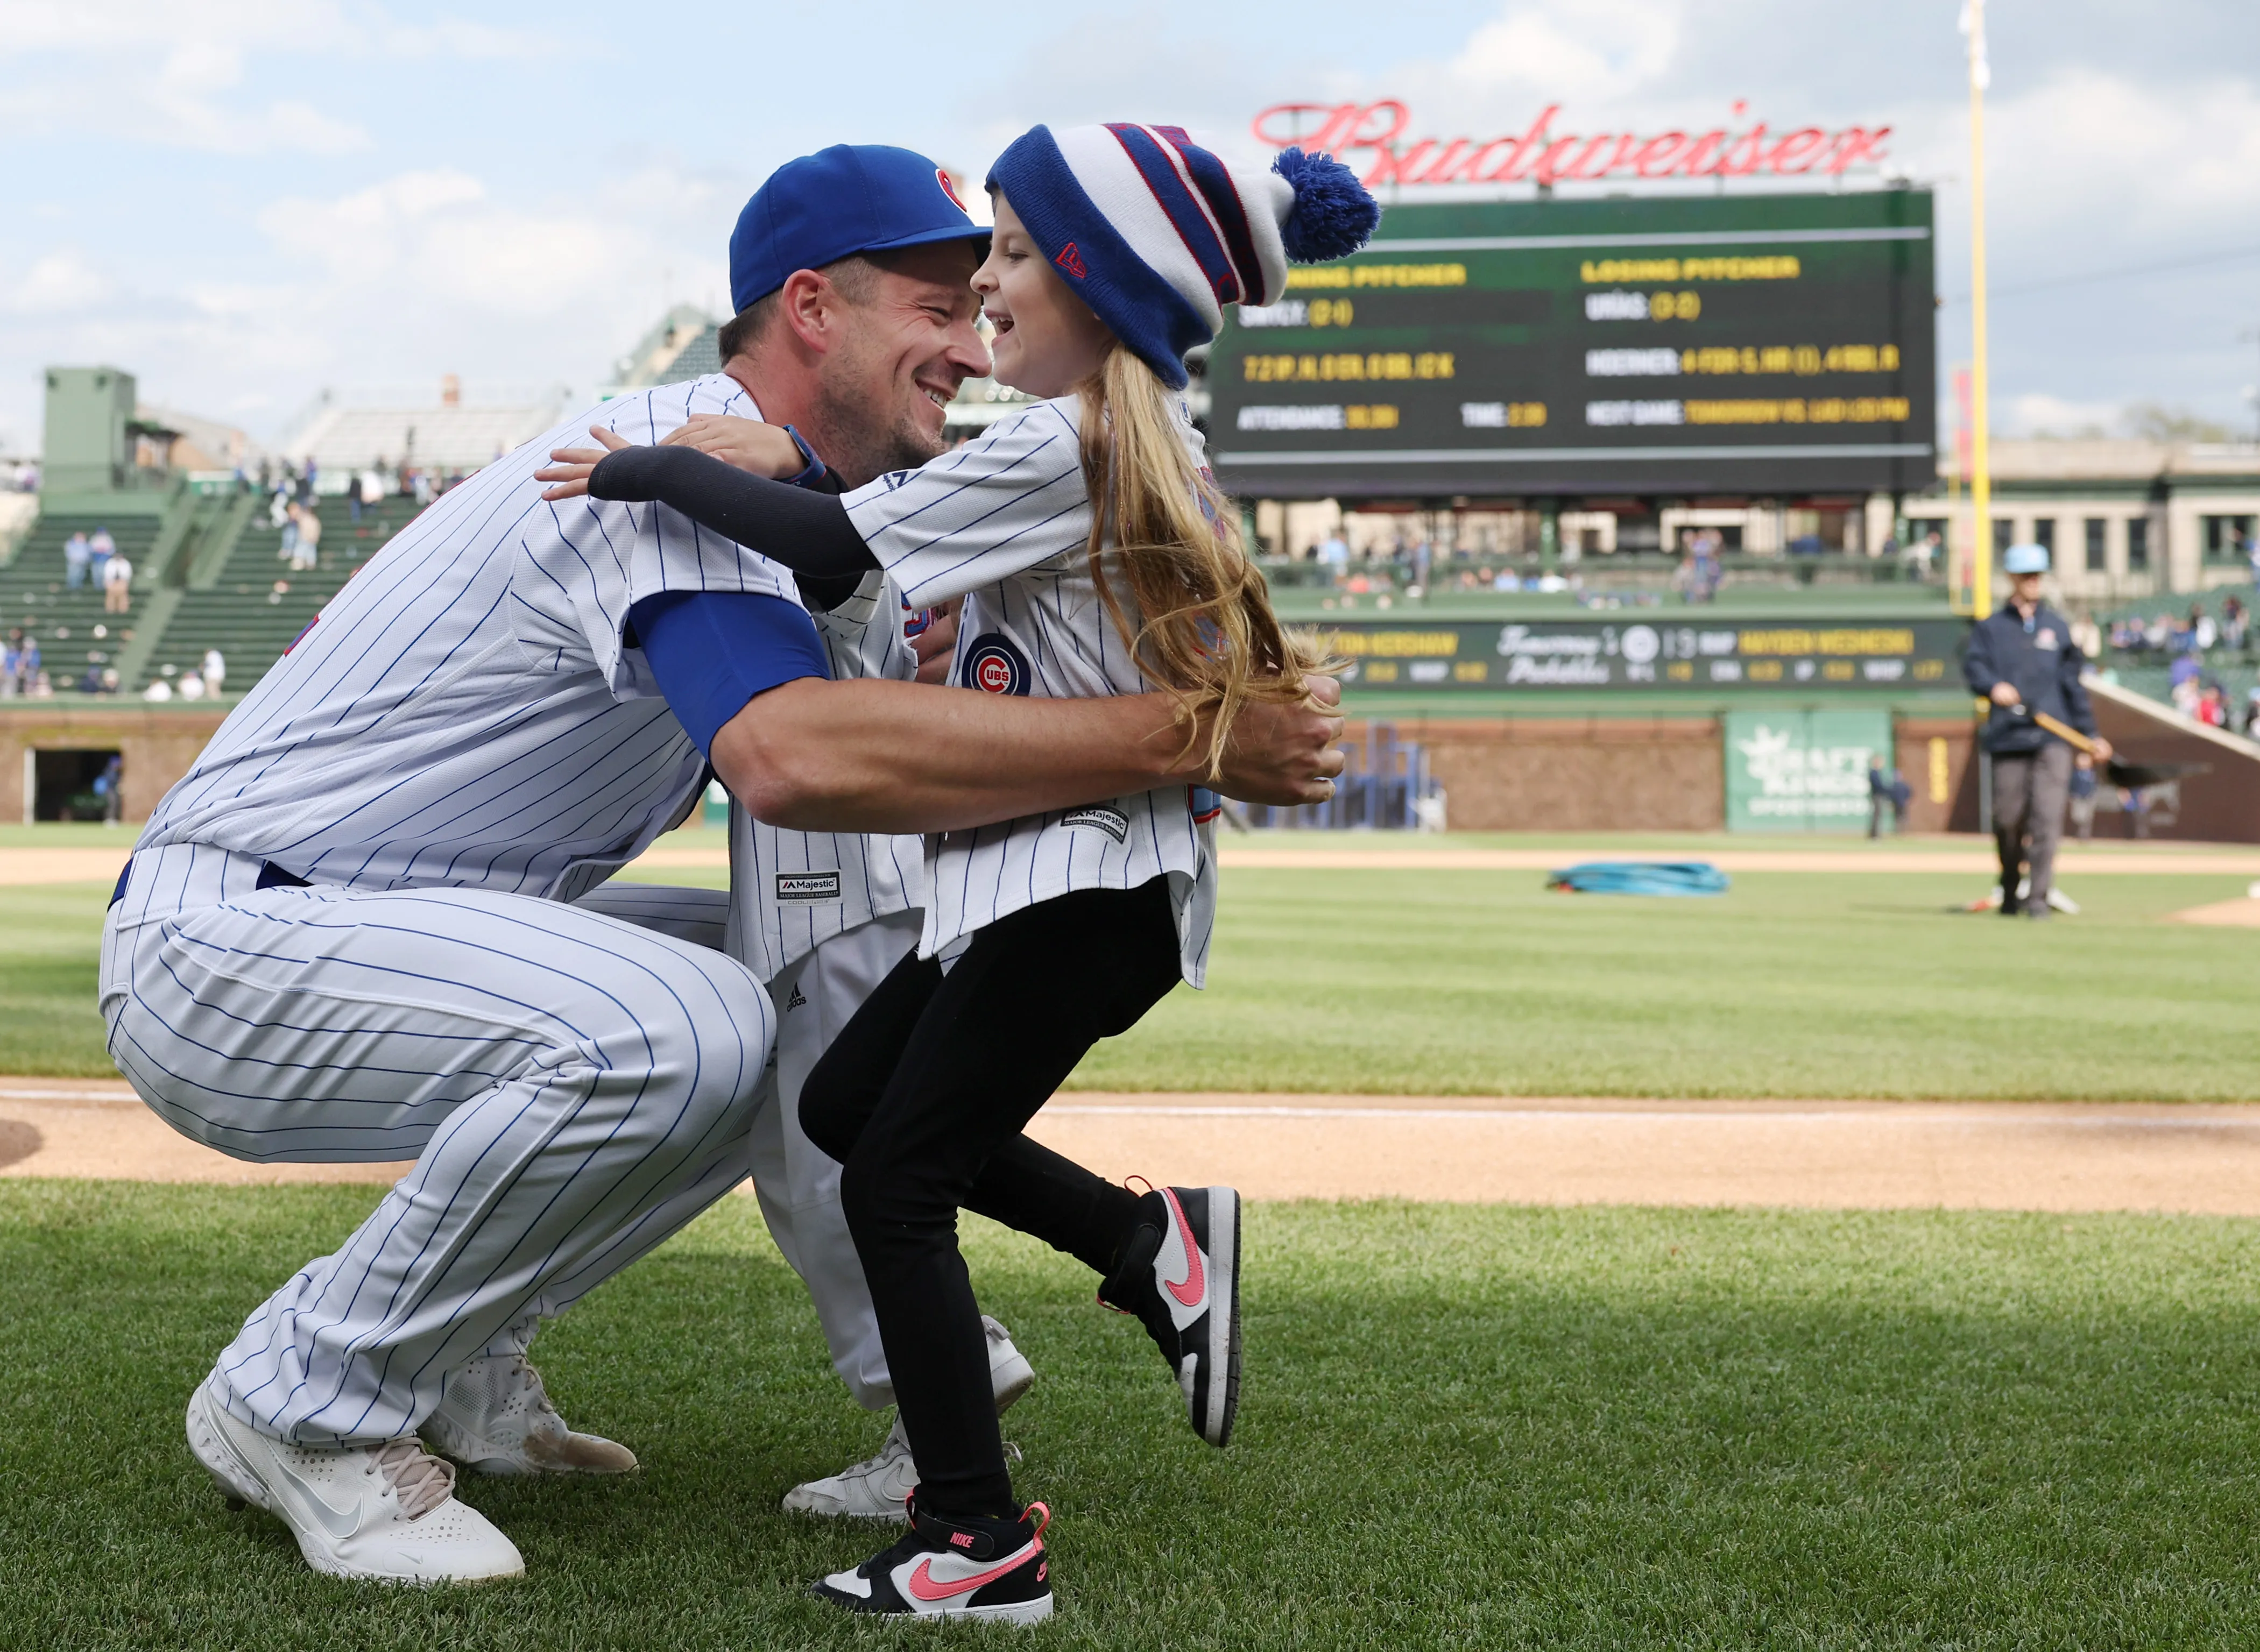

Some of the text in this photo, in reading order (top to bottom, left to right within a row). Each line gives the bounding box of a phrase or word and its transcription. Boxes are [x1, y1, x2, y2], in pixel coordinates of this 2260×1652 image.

[1251, 99, 1894, 187] Budweiser
[1353, 263, 1466, 287] PITCHER
[1580, 256, 1800, 283] LOSING PITCHER
[978, 657, 1009, 692] CUBS
[1083, 820, 1105, 829] LEAGUE
[1085, 810, 1124, 829] Majestic
[796, 880, 834, 891] Majestic
[787, 996, 807, 1012] adidas
[950, 1532, 974, 1548] NIKE
